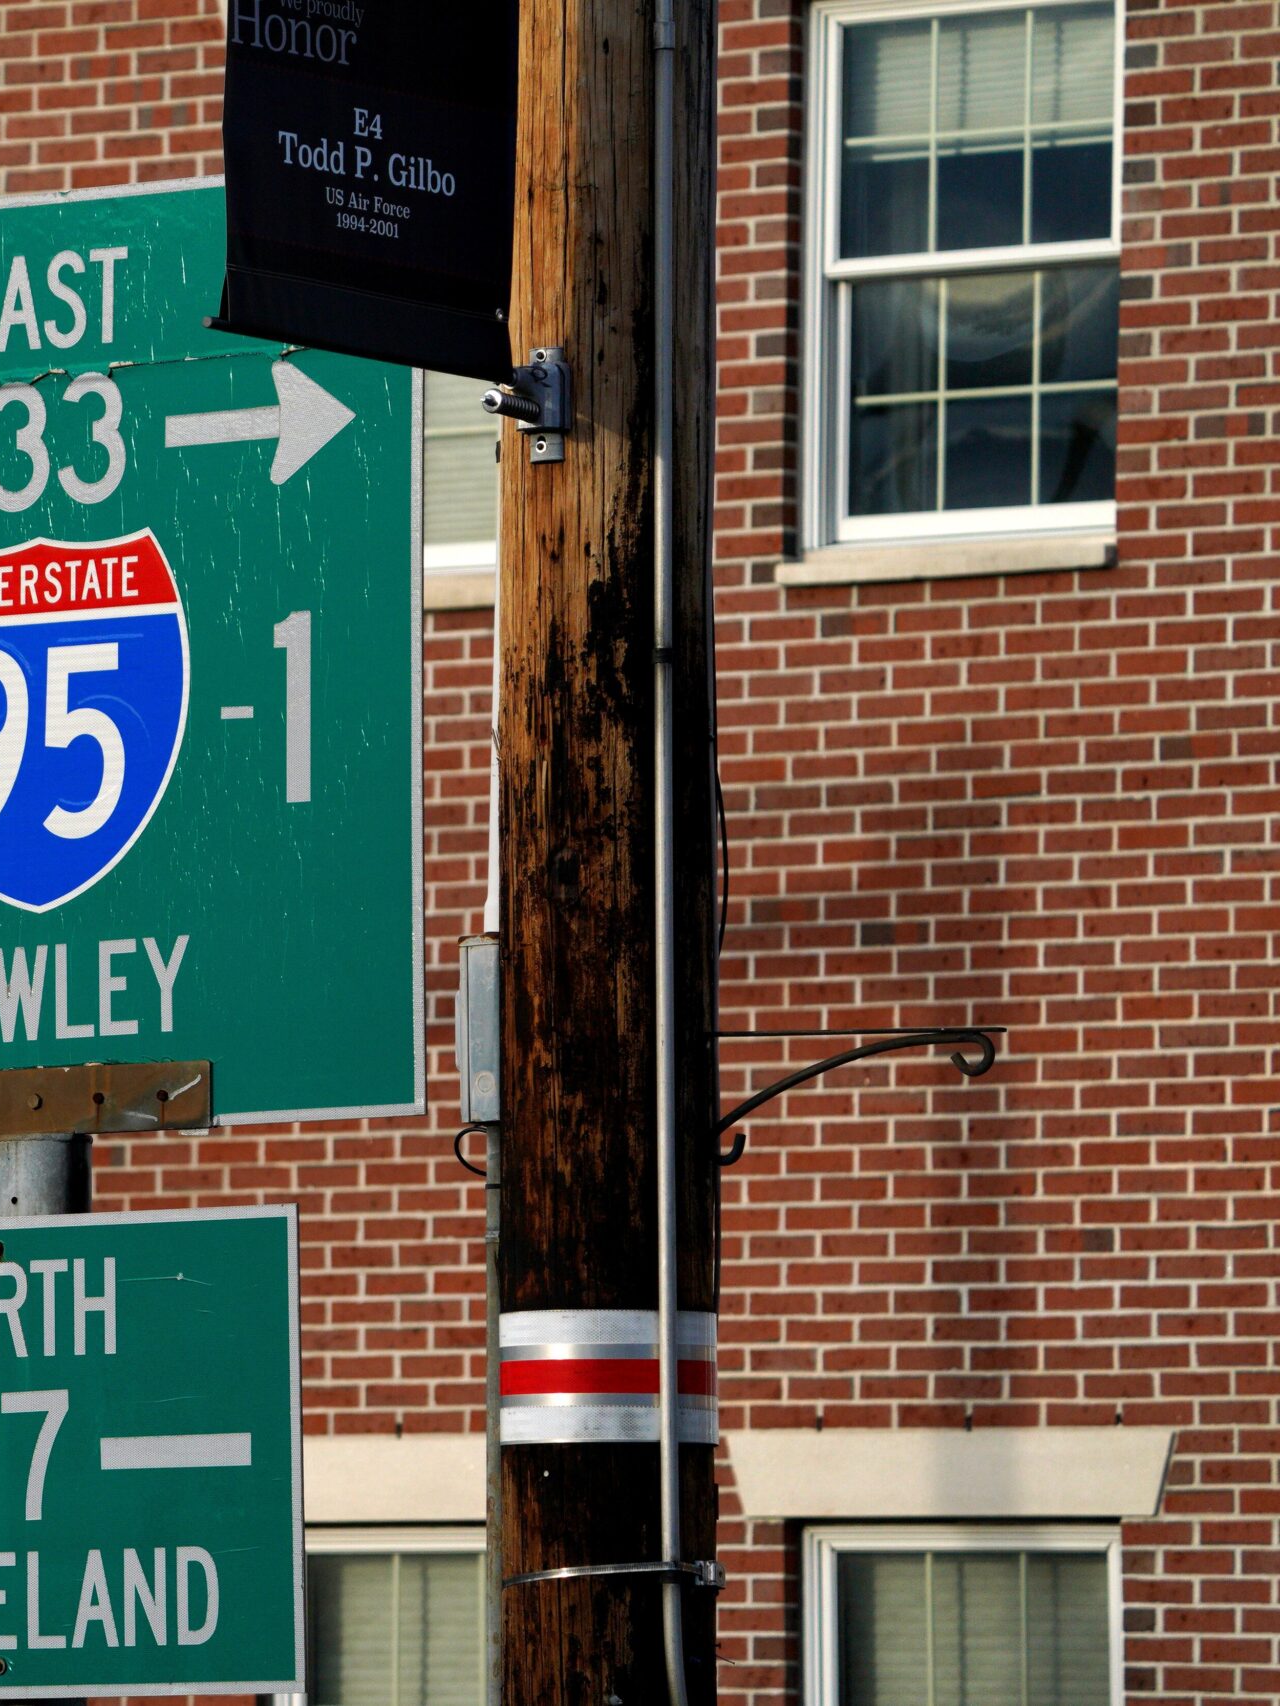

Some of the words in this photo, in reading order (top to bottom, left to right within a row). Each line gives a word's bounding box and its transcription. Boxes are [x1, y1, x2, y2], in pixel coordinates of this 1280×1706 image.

[306, 0, 365, 28] proudly
[231, 0, 358, 66] Honor
[353, 107, 383, 140] E4
[278, 131, 346, 175] Todd
[354, 145, 379, 182] P.
[388, 153, 456, 197] Gilbo
[325, 186, 344, 206] US
[348, 191, 370, 212] Air
[373, 196, 411, 219] Force
[336, 211, 399, 239] 1994-2001
